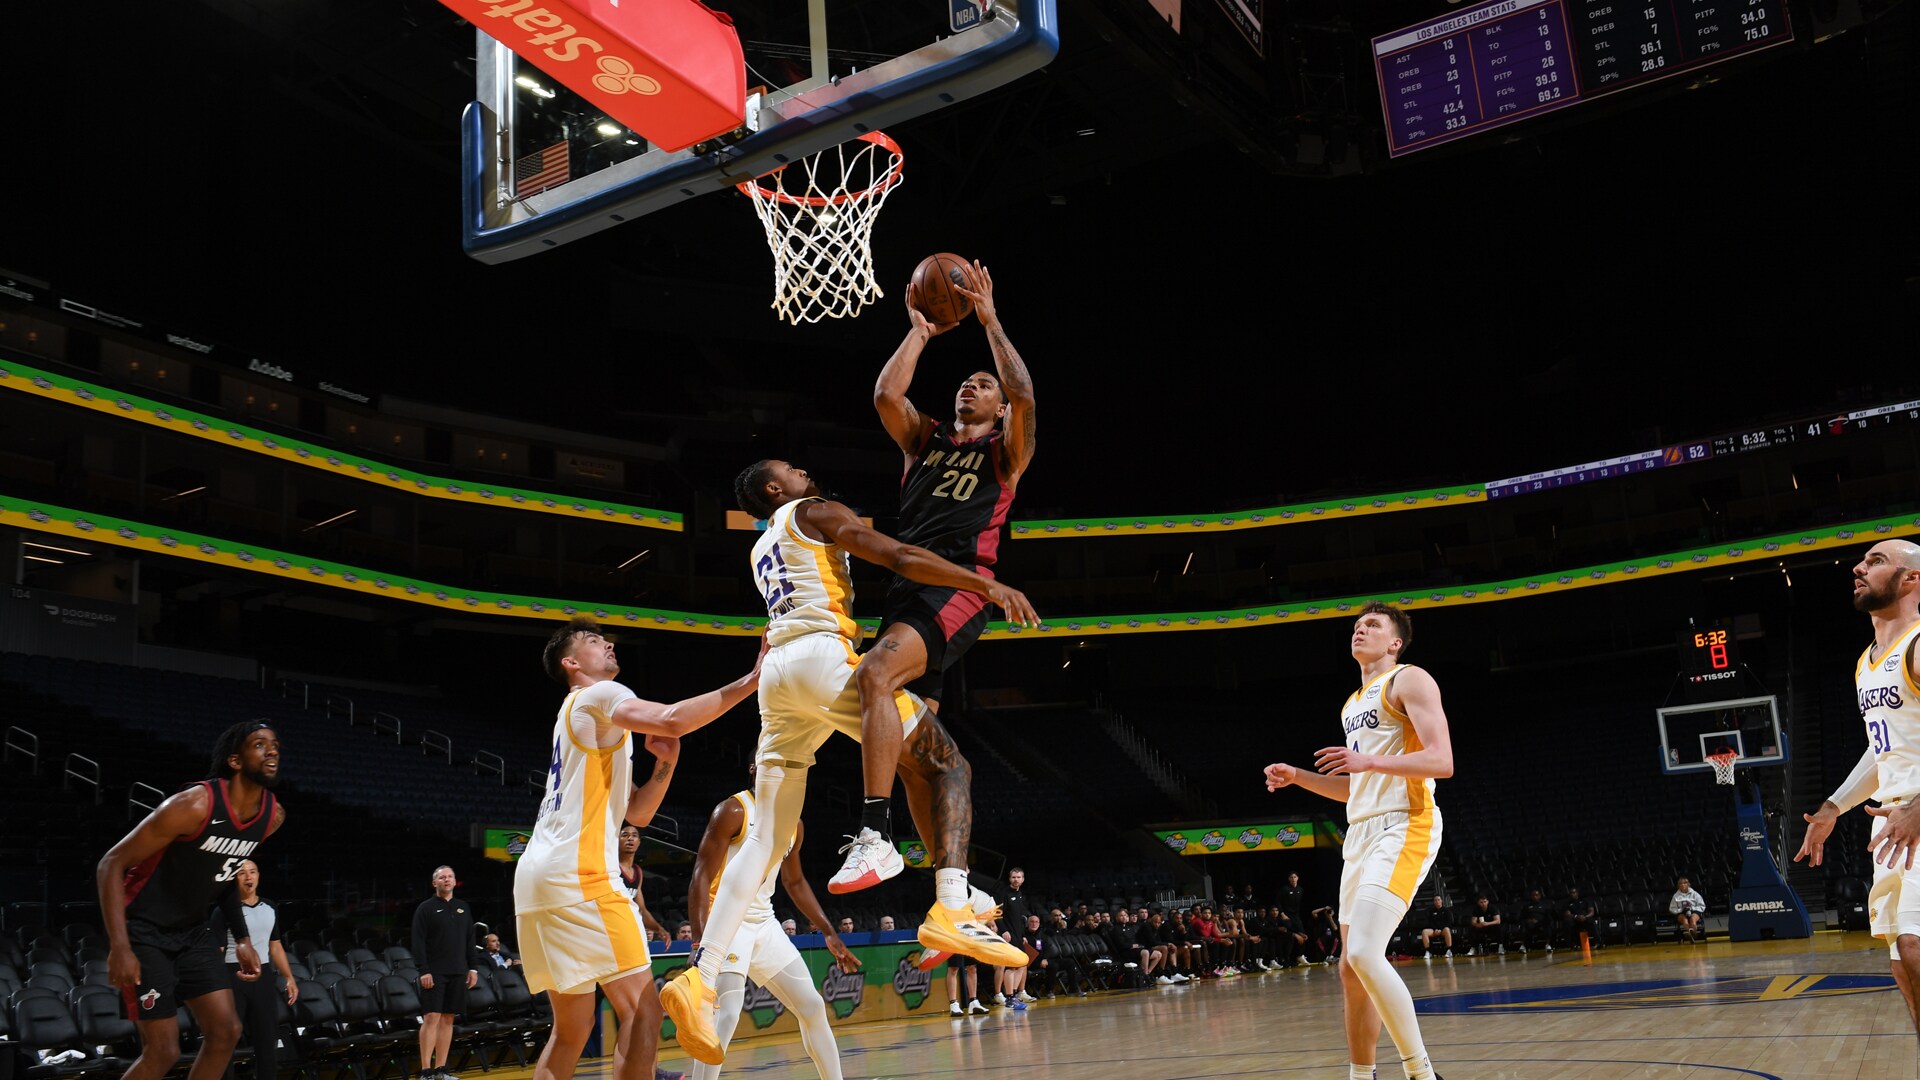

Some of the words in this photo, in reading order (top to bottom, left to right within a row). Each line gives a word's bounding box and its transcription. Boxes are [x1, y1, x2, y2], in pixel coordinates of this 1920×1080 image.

[956, 7, 975, 26] NBA
[1540, 8, 1546, 20] 5
[1588, 6, 1612, 19] OREB
[1644, 8, 1656, 20] 15
[1694, 8, 1715, 20] PITP
[1740, 8, 1765, 24] 34.0
[1417, 29, 1432, 40] LOS
[1434, 16, 1467, 34] ANGELES
[1468, 9, 1490, 24] TEAM
[1491, 1, 1516, 16] STATS
[478, 0, 603, 61] Stat
[1486, 26, 1502, 36] BLK
[1538, 25, 1549, 37] 13
[1592, 22, 1615, 34] DREB
[1651, 23, 1658, 34] 7
[1698, 24, 1719, 36] FG%
[1744, 24, 1768, 41] 75.0
[1443, 38, 1453, 50] 13
[1488, 42, 1499, 50] TO
[1544, 40, 1552, 51] 8
[1594, 41, 1610, 50] STL
[1640, 40, 1662, 55] 36.1
[1701, 41, 1720, 52] FT%
[1396, 54, 1411, 64] AST
[1450, 54, 1456, 65] 8
[1491, 56, 1508, 66] POT
[1542, 56, 1554, 68] 26
[1597, 56, 1616, 67] 2P%
[1641, 56, 1664, 72] 28.6
[1398, 67, 1420, 79] OREB
[1446, 69, 1458, 82] 23
[1494, 70, 1512, 82] PITP
[1600, 72, 1619, 83] 3P%
[1536, 72, 1557, 87] 39.6
[1401, 83, 1422, 95] DREB
[1455, 85, 1461, 95] 7
[1496, 87, 1515, 97] FG%
[1538, 87, 1560, 102] 69.2
[1403, 100, 1418, 110] STL
[1443, 100, 1464, 114] 42.4
[1500, 102, 1516, 113] FT%
[1406, 114, 1423, 125] 2P%
[1446, 115, 1466, 130] 33.3
[1408, 129, 1426, 140] 3P%
[248, 358, 294, 382] Adobe
[1858, 420, 1867, 429] 10
[1885, 415, 1890, 423] 7
[1909, 410, 1918, 419] 15
[1807, 423, 1820, 437] 41
[1742, 431, 1766, 445] 6:32
[1689, 445, 1705, 459] 52
[1534, 481, 1542, 489] 23
[1557, 477, 1562, 485] 7
[1600, 469, 1608, 477] 13
[1624, 464, 1629, 472] 8
[1645, 460, 1654, 468] 26
[931, 470, 979, 502] 20
[757, 542, 796, 609] 21
[62, 608, 116, 622] DOORDASH
[1695, 630, 1728, 648] 6:32
[1710, 645, 1729, 669] 8
[1702, 670, 1736, 682] TISSOT
[1345, 709, 1380, 734] LAKERS
[1869, 719, 1891, 754] 31
[200, 835, 259, 857] MIAMI
[822, 964, 865, 1004] Starry
[893, 959, 932, 998] Starry
